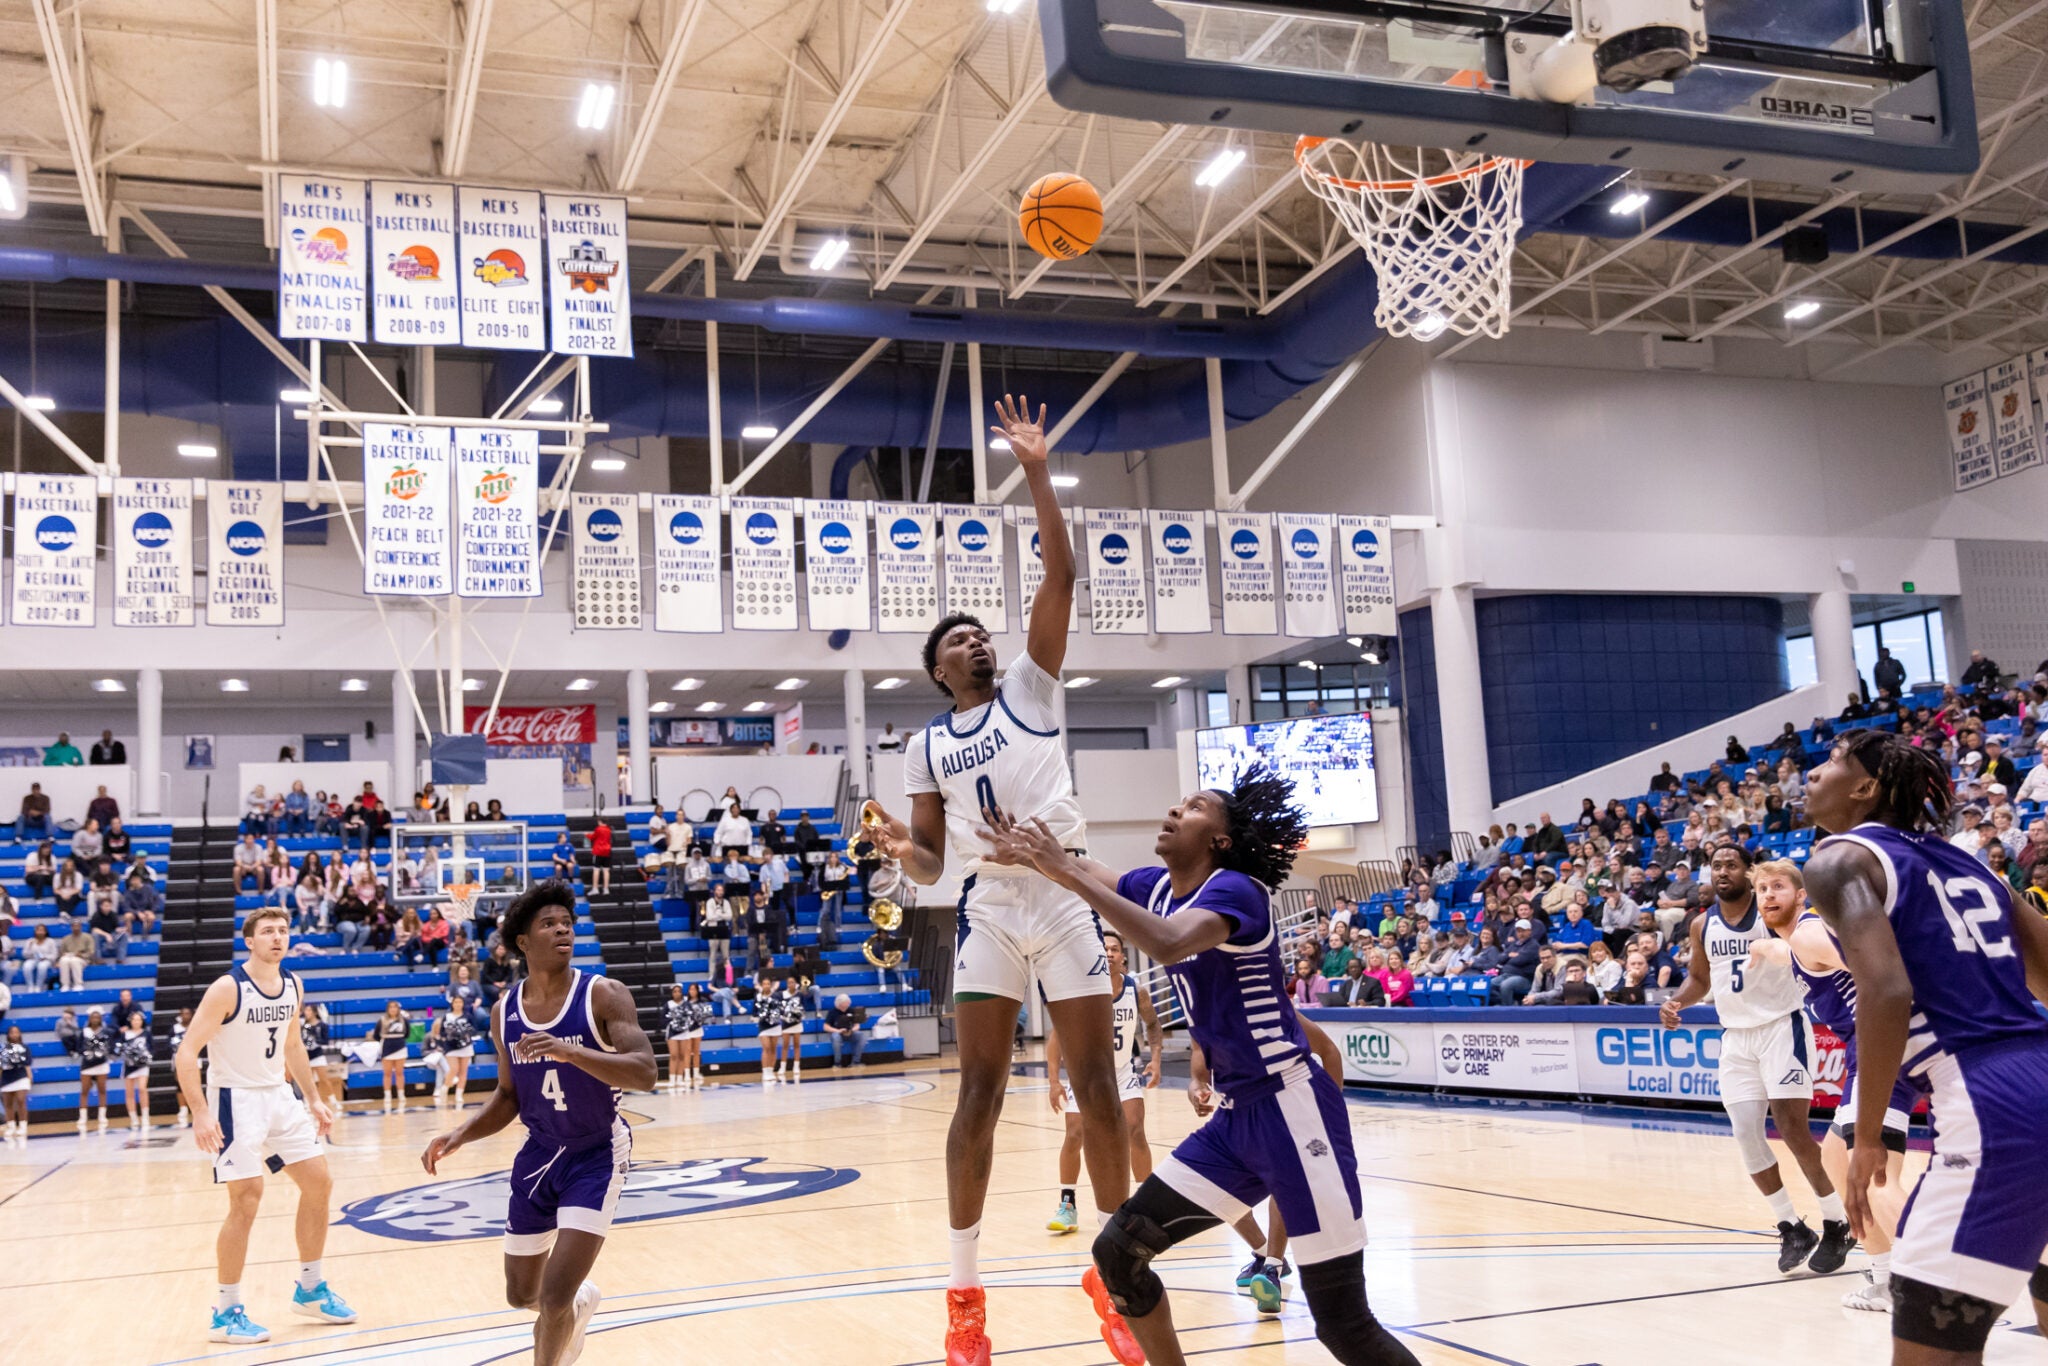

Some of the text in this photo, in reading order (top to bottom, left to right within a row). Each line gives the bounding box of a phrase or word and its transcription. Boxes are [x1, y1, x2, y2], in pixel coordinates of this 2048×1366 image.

[304, 183, 342, 200] MEN'S
[395, 193, 432, 208] MEN'S
[482, 199, 519, 214] MEN'S
[283, 203, 364, 223] BASKETBALL
[569, 203, 601, 217] MEN'S
[376, 216, 451, 233] BASKETBALL
[464, 221, 537, 239] BASKETBALL
[552, 219, 620, 236] BASKETBALL
[283, 273, 364, 291] NATIONAL
[284, 293, 363, 311] FINALIST
[377, 294, 456, 310] FINAL FOUR
[464, 298, 540, 315] ELITE EIGHT
[565, 299, 616, 314] NATIONAL
[296, 316, 352, 332] 2007-08
[390, 319, 445, 334] 2008-09
[478, 323, 529, 338] 2009-10
[569, 317, 612, 332] FINALIST
[568, 335, 616, 350] 2021-22
[391, 428, 424, 444] MEN'S
[481, 433, 512, 448] MEN'S
[372, 444, 444, 462] BASKETBALL
[461, 449, 531, 465] BASKETBALL
[39, 481, 75, 494] MEN'S
[136, 481, 171, 494] MEN'S
[228, 488, 262, 501] MEN'S
[610, 496, 630, 506] GOLF
[19, 497, 92, 512] BASKETBALL
[118, 495, 189, 509] BASKETBALL
[230, 502, 259, 515] GOLF
[692, 499, 712, 510] GOLF
[752, 501, 791, 510] BASKETBALL
[382, 505, 433, 520] 2021-22
[472, 507, 522, 522] 2021-22
[812, 511, 859, 521] BASKETBALL
[907, 506, 932, 515] TENNIS
[979, 508, 1001, 517] TENNIS
[1159, 512, 1194, 521] BASEBALL
[1087, 521, 1140, 530] CROSS COUNTRY
[1283, 516, 1326, 526] VOLLEYBALL
[372, 526, 444, 543] PEACH BELT
[463, 523, 532, 539] PEACH BELT
[589, 523, 623, 535] NCAA
[672, 526, 704, 538] NCAA
[892, 532, 922, 543] NCAA
[961, 534, 989, 545] NCAA
[1165, 538, 1192, 548] NCAA
[466, 541, 530, 557] CONFERENCE
[584, 545, 618, 555] DIVISION
[680, 549, 710, 559] DIVISION
[756, 548, 782, 557] DIVISION
[1102, 548, 1130, 558] NCAA
[1233, 543, 1260, 553] NCAA
[136, 551, 171, 564] SOUTH
[375, 550, 440, 566] CONFERENCE
[578, 557, 635, 567] CHAMPIONSHIP
[737, 559, 790, 568] CHAMPIONSHIP
[830, 556, 855, 565] DIVISION
[900, 554, 925, 562] DIVISION
[967, 554, 992, 563] DIVISION
[1173, 557, 1196, 566] DIVISION
[220, 562, 271, 575] CENTRAL
[467, 558, 530, 574] TOURNAMENT
[660, 560, 715, 570] CHAMPIONSHIP
[811, 566, 864, 576] CHAMPIONSHIP
[882, 564, 933, 573] CHAMPIONSHIP
[950, 564, 1001, 574] CHAMPIONSHIP
[127, 566, 180, 578] ATLANTIC
[579, 568, 636, 578] APPEARANCES
[661, 573, 715, 583] APPEARANCES
[740, 570, 787, 579] PARTICIPANT
[1098, 568, 1126, 577] DIVISION
[1346, 574, 1389, 583] CHAMPIONSHIP
[26, 572, 83, 586] REGIONAL
[218, 577, 273, 590] REGIONAL
[373, 573, 443, 589] CHAMPIONS
[465, 577, 532, 592] CHAMPIONS
[815, 576, 861, 585] PARTICIPANT
[886, 575, 930, 584] PARTICIPANT
[954, 575, 997, 585] PARTICIPANT
[1093, 579, 1140, 588] CHAMPIONSHIP
[127, 581, 181, 593] REGIONAL
[1097, 589, 1139, 597] PARTICIPANT
[1290, 582, 1327, 591] PARTICIPAN
[1347, 584, 1390, 594] APPEARANCES
[213, 592, 278, 605] CHAMPIONS
[734, 723, 772, 741] BITES
[976, 774, 1001, 824] 0
[1926, 869, 2017, 959] 12
[1711, 939, 1751, 957] AUGU
[1731, 959, 1746, 993] 5
[265, 1027, 279, 1059] 3
[1346, 1034, 1390, 1058] HCCU
[1462, 1034, 1520, 1048] CENTER FOR
[1441, 1047, 1460, 1060] CPC
[1596, 1027, 1722, 1069] GEICO
[1463, 1048, 1505, 1062] PRIMARY
[1464, 1063, 1490, 1076] CARE
[1628, 1069, 1721, 1096] Local Offic
[541, 1068, 568, 1112] 4
